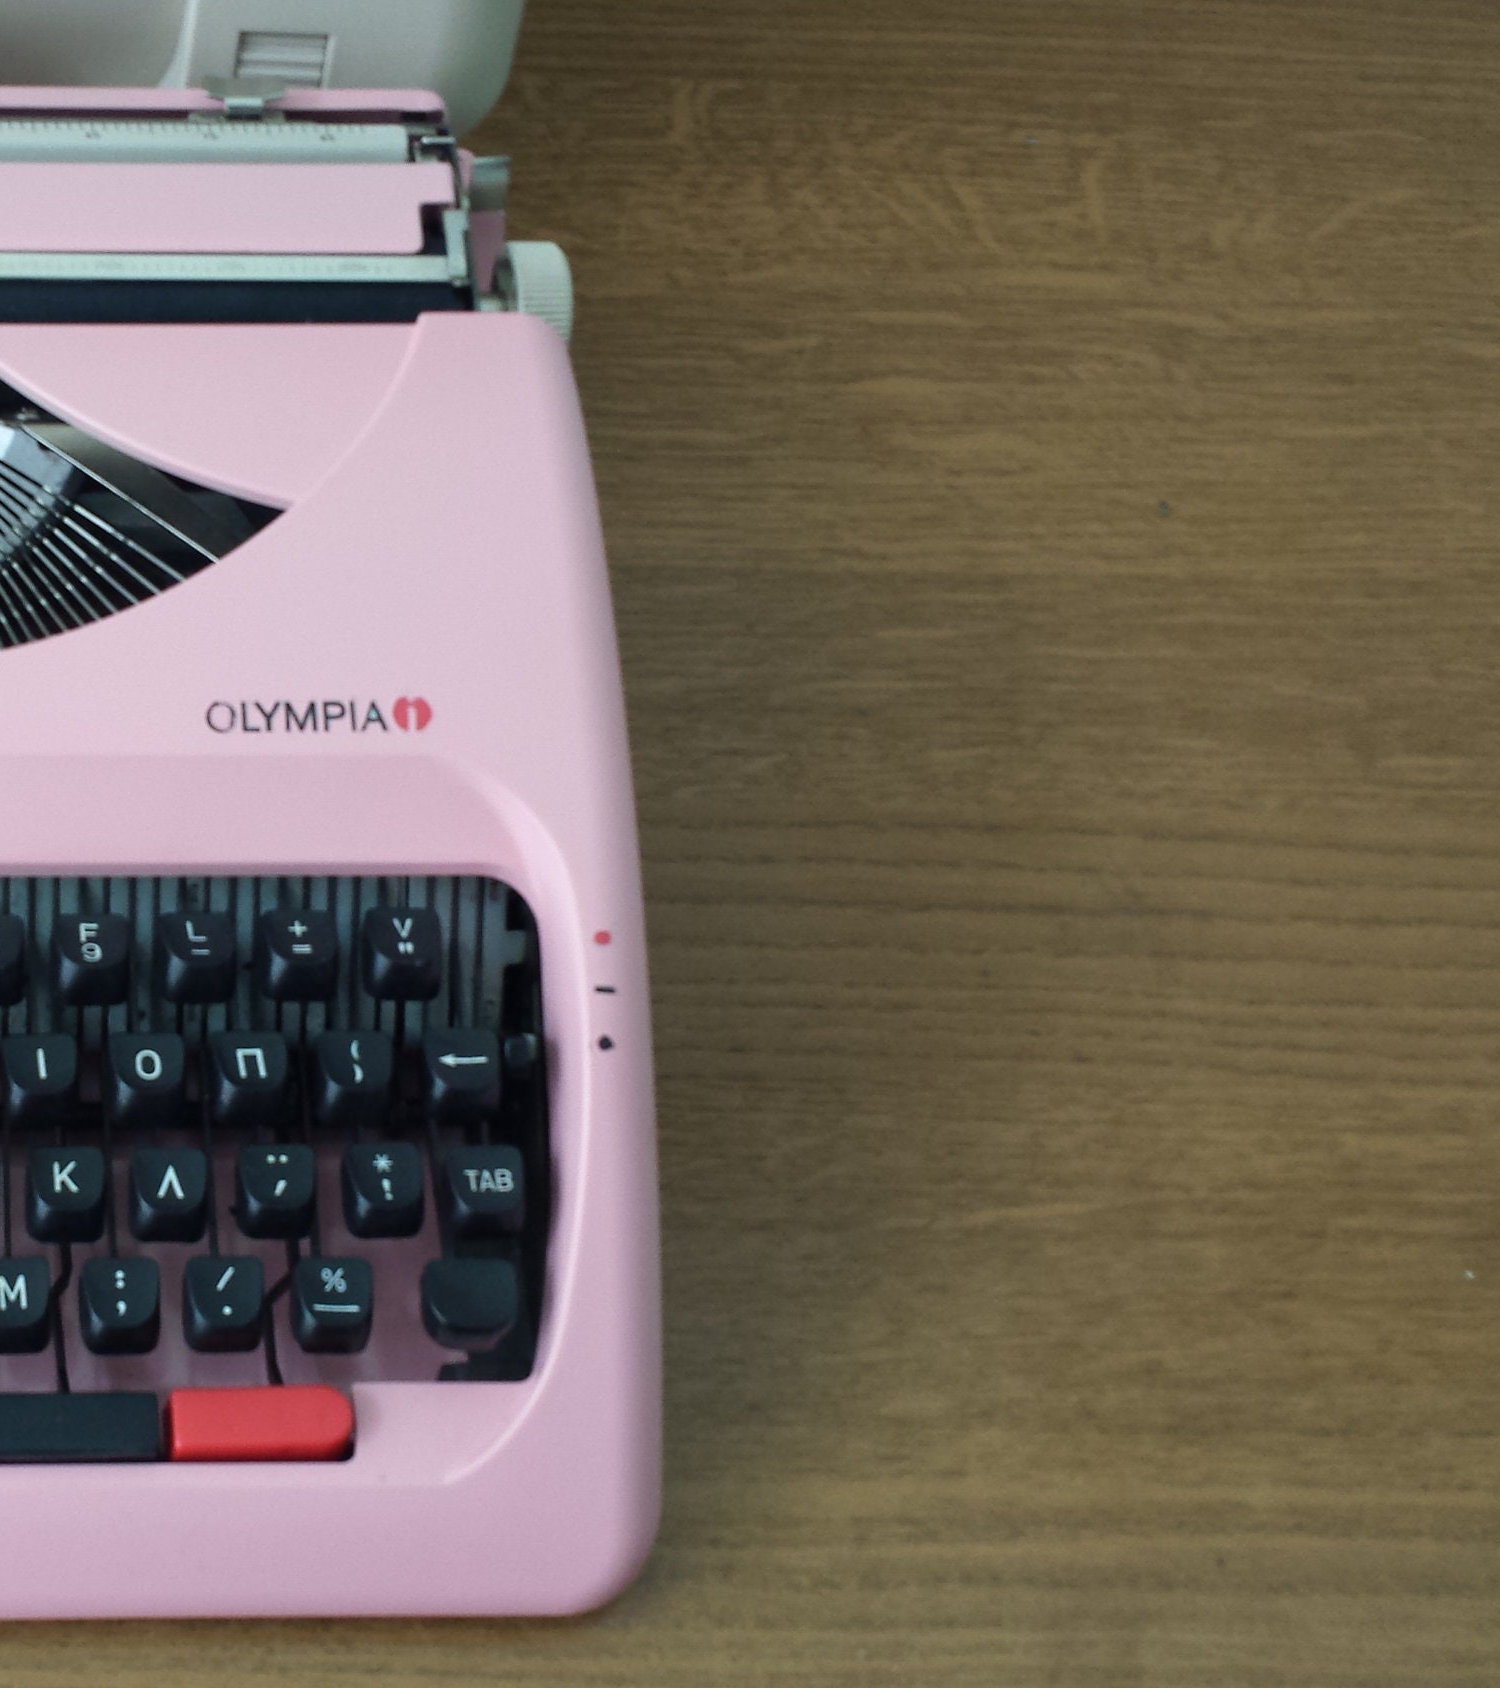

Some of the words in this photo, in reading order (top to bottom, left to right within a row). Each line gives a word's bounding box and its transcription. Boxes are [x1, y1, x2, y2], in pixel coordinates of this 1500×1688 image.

[205, 700, 389, 734] OLYMPIA
[78, 922, 100, 943] F
[184, 920, 208, 942] L
[391, 918, 414, 939] V
[80, 942, 103, 962] 9
[463, 1168, 515, 1193] TAB
